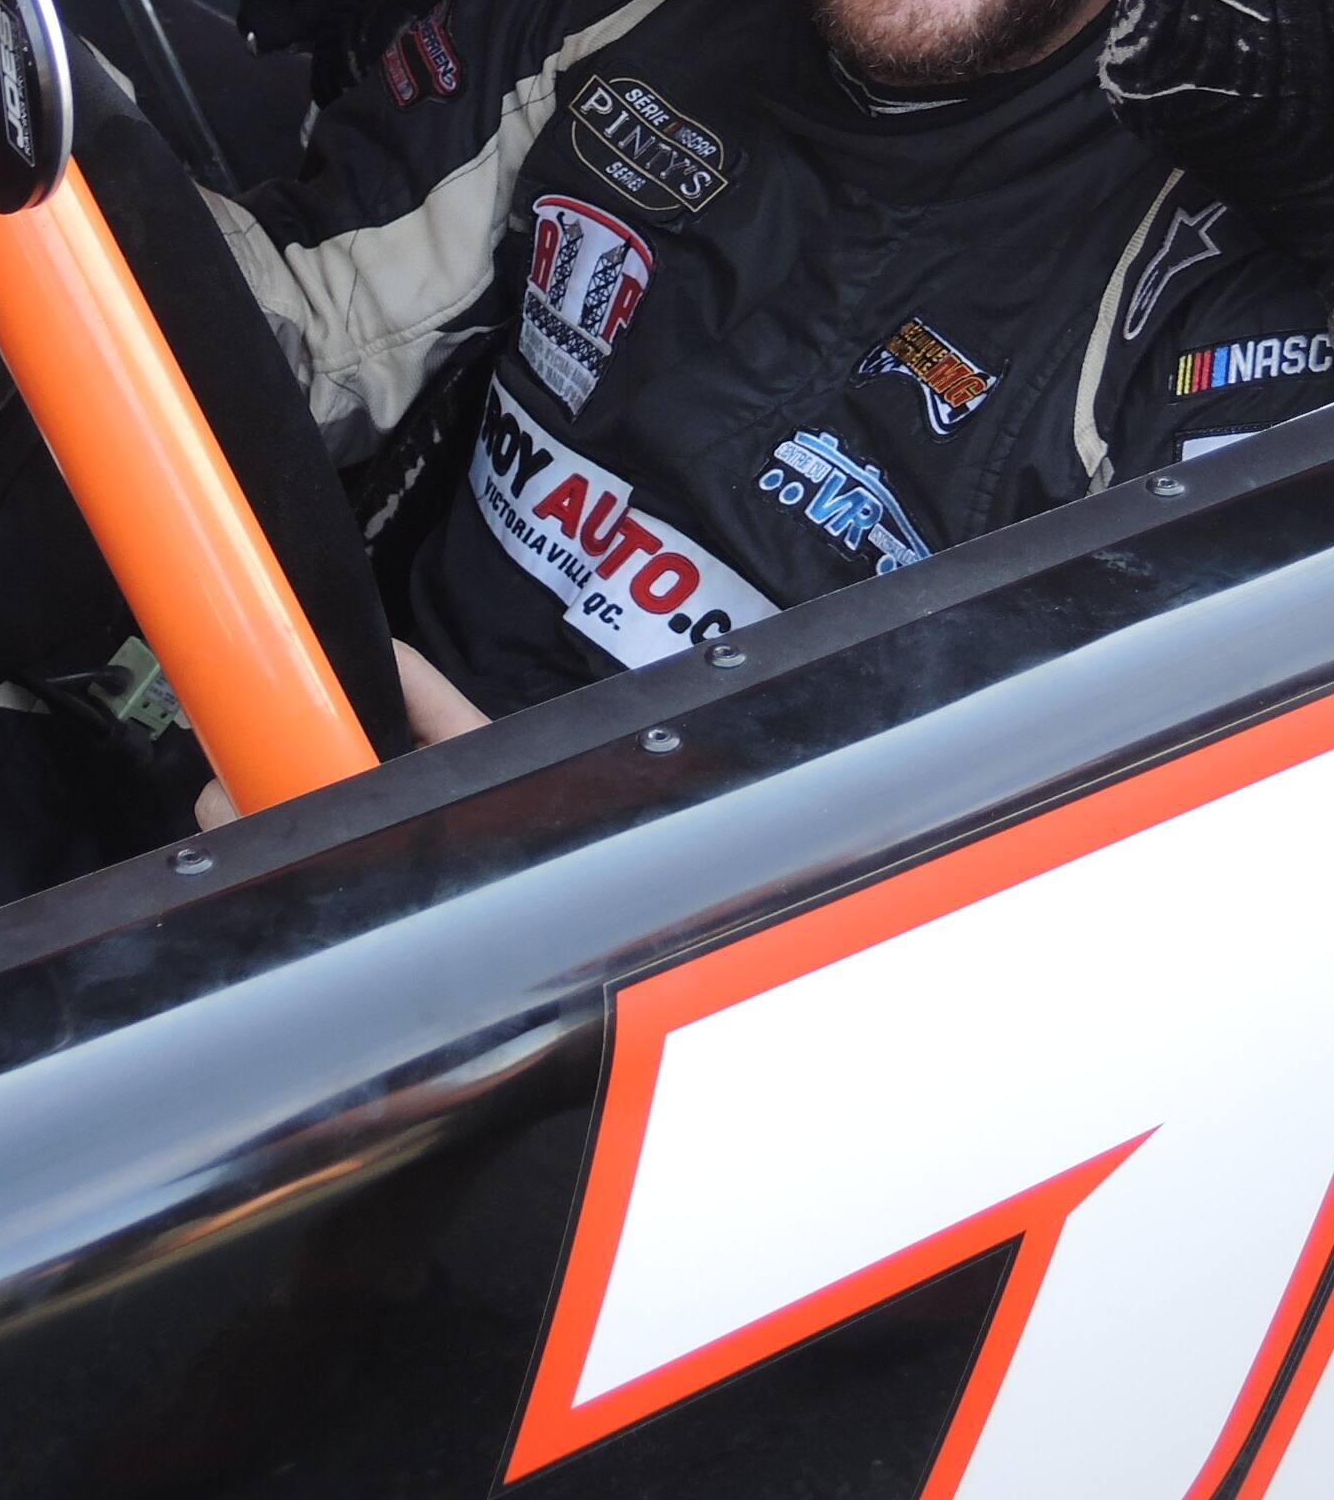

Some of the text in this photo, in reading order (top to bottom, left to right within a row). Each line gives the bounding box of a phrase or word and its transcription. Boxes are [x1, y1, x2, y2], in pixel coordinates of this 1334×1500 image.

[579, 86, 713, 200] PINTY'S
[624, 87, 670, 127] SÉRIE
[804, 466, 884, 551] VR
